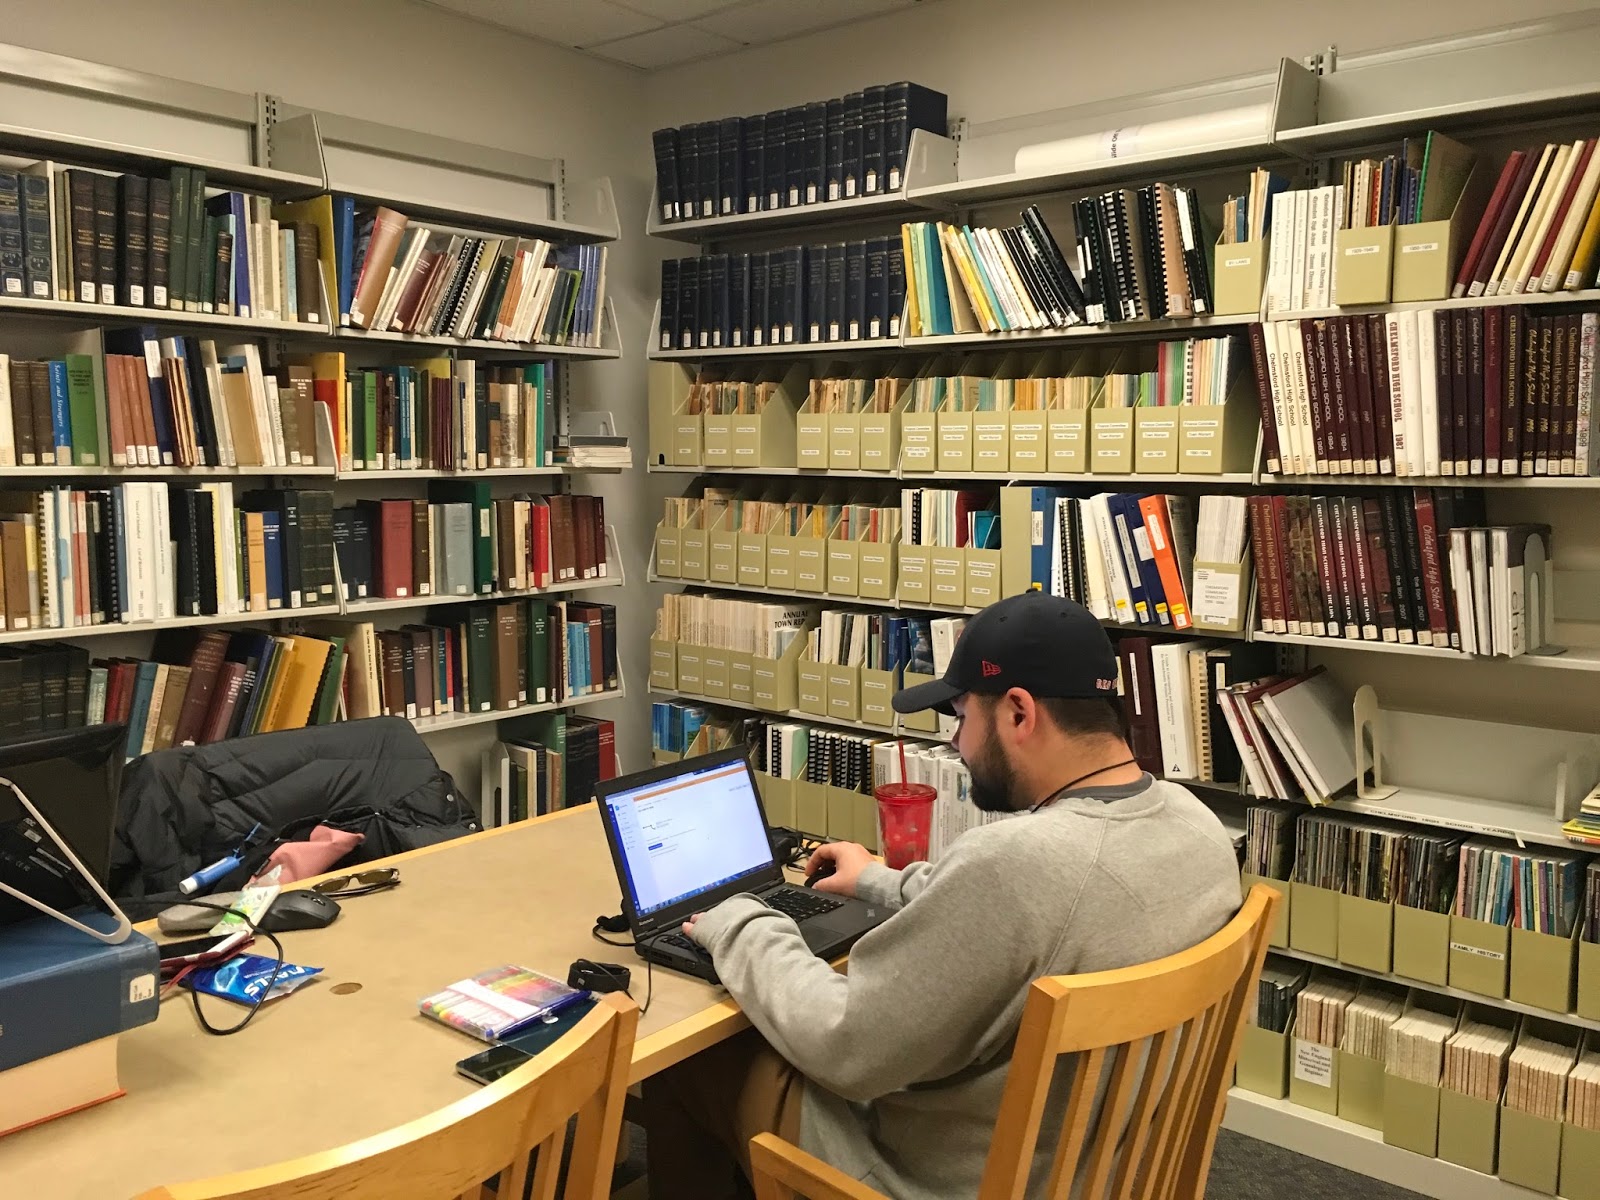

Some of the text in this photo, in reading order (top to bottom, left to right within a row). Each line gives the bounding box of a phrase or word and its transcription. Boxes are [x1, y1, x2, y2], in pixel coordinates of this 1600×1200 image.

[1296, 352, 1304, 388] Chelmsford
[1270, 352, 1279, 388] Chelmsford
[1276, 405, 1284, 426] School
[1282, 352, 1292, 388] Chelmsford
[1288, 404, 1296, 426] School
[1390, 321, 1404, 450] CHELMSFORD HIGH SCHOOL 1987
[1298, 388, 1306, 404] High
[783, 610, 808, 620] ANNUAL
[1399, 604, 1407, 620] 2007
[774, 620, 792, 628] TOWN
[1370, 808, 1417, 821] CHELMSFORD
[1444, 821, 1474, 830] SCHOOL
[1454, 944, 1502, 958] FAMILY HISTORY
[1304, 1068, 1323, 1076] Register
